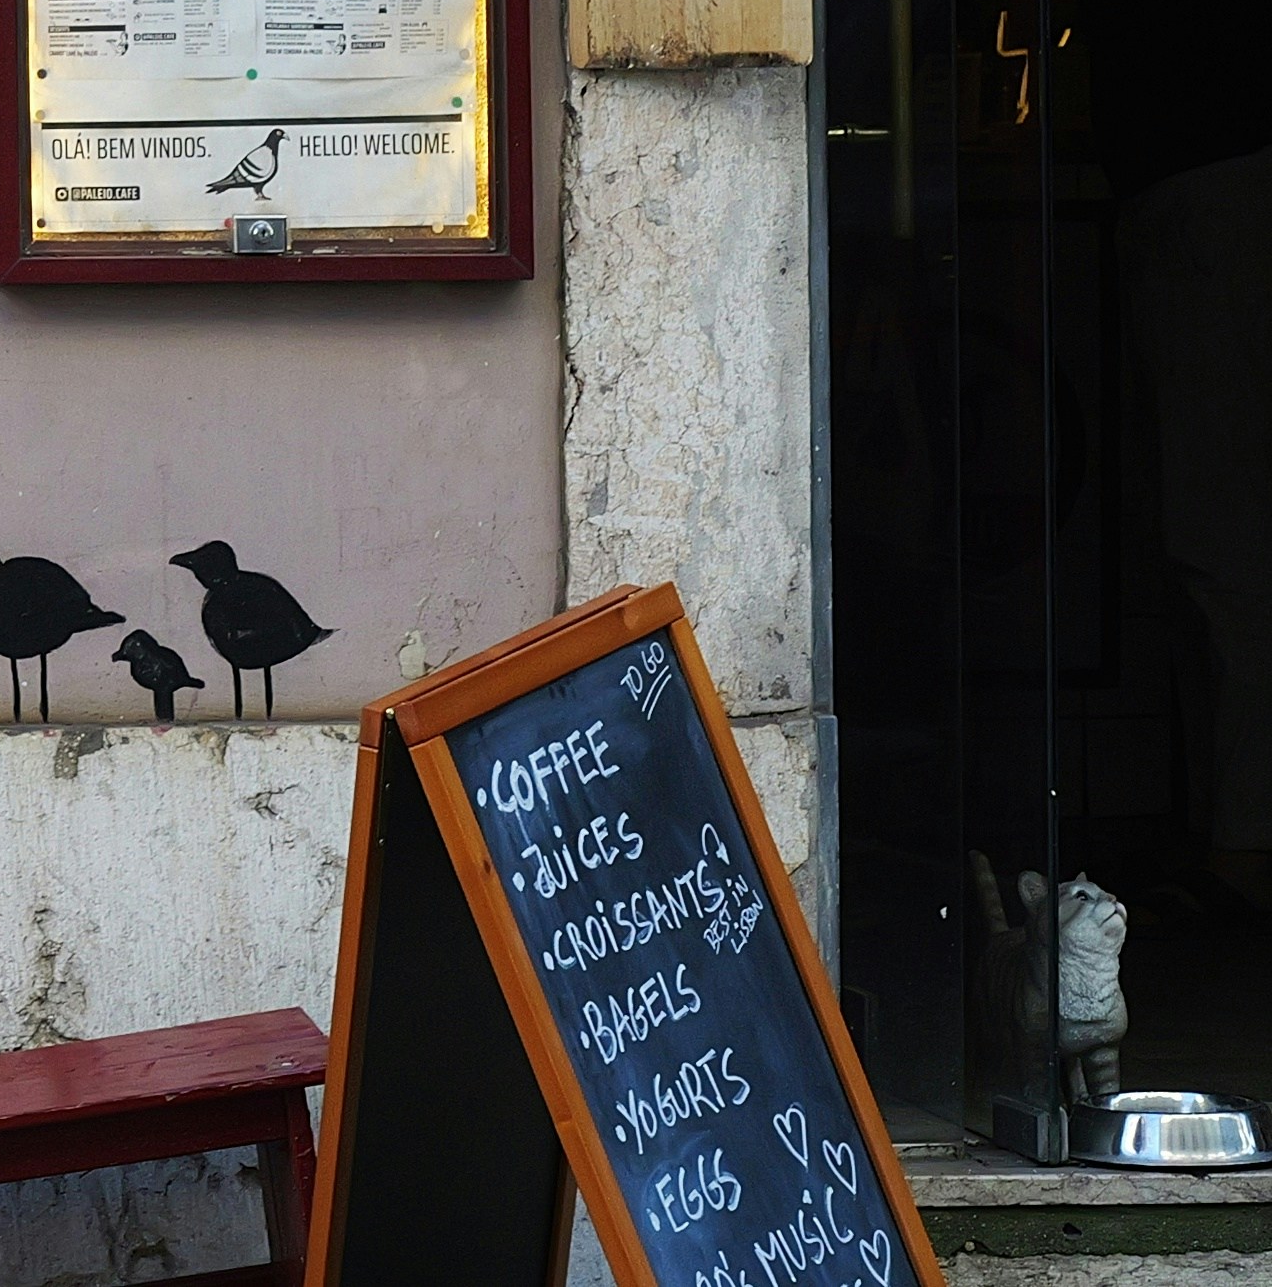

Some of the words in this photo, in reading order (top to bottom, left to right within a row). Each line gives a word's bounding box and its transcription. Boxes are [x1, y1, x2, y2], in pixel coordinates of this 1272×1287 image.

[52, 133, 91, 160] OLÁ!
[97, 137, 135, 160] BEM
[141, 136, 212, 159] VINDOS.
[300, 134, 359, 157] HELLO!
[364, 132, 456, 156] WELCOME.
[72, 187, 139, 201] @PALEIO.CAFE
[620, 665, 643, 701] TO
[641, 641, 665, 675] GO
[491, 720, 620, 812] COFFEE
[703, 900, 732, 956] BEST
[582, 963, 701, 1065] BAGELS
[616, 1047, 751, 1155] YOGURTS
[655, 1148, 742, 1233] EGGS
